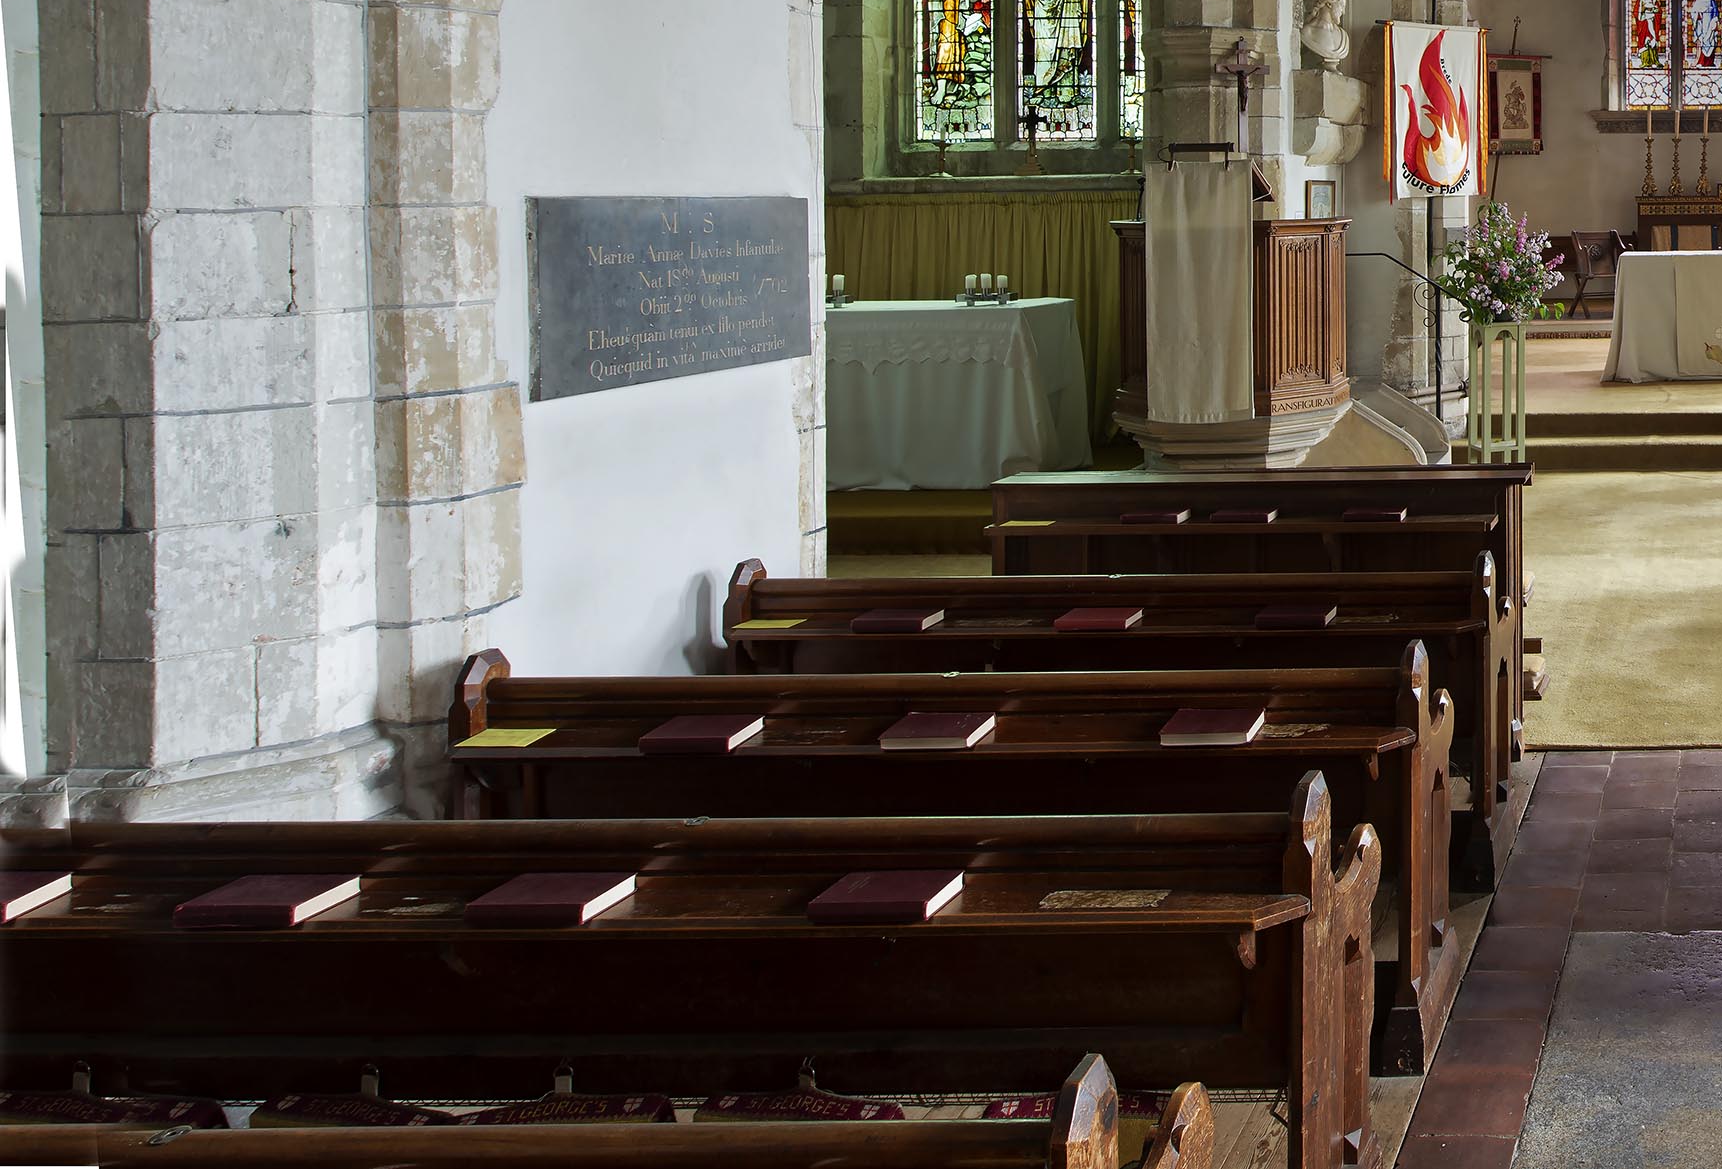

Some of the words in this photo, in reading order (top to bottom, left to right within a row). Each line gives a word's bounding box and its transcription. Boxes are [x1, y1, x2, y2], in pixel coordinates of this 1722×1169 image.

[1440, 169, 1470, 194] Flames
[660, 212, 679, 234] M
[703, 212, 714, 233] S
[690, 240, 733, 260] Davies
